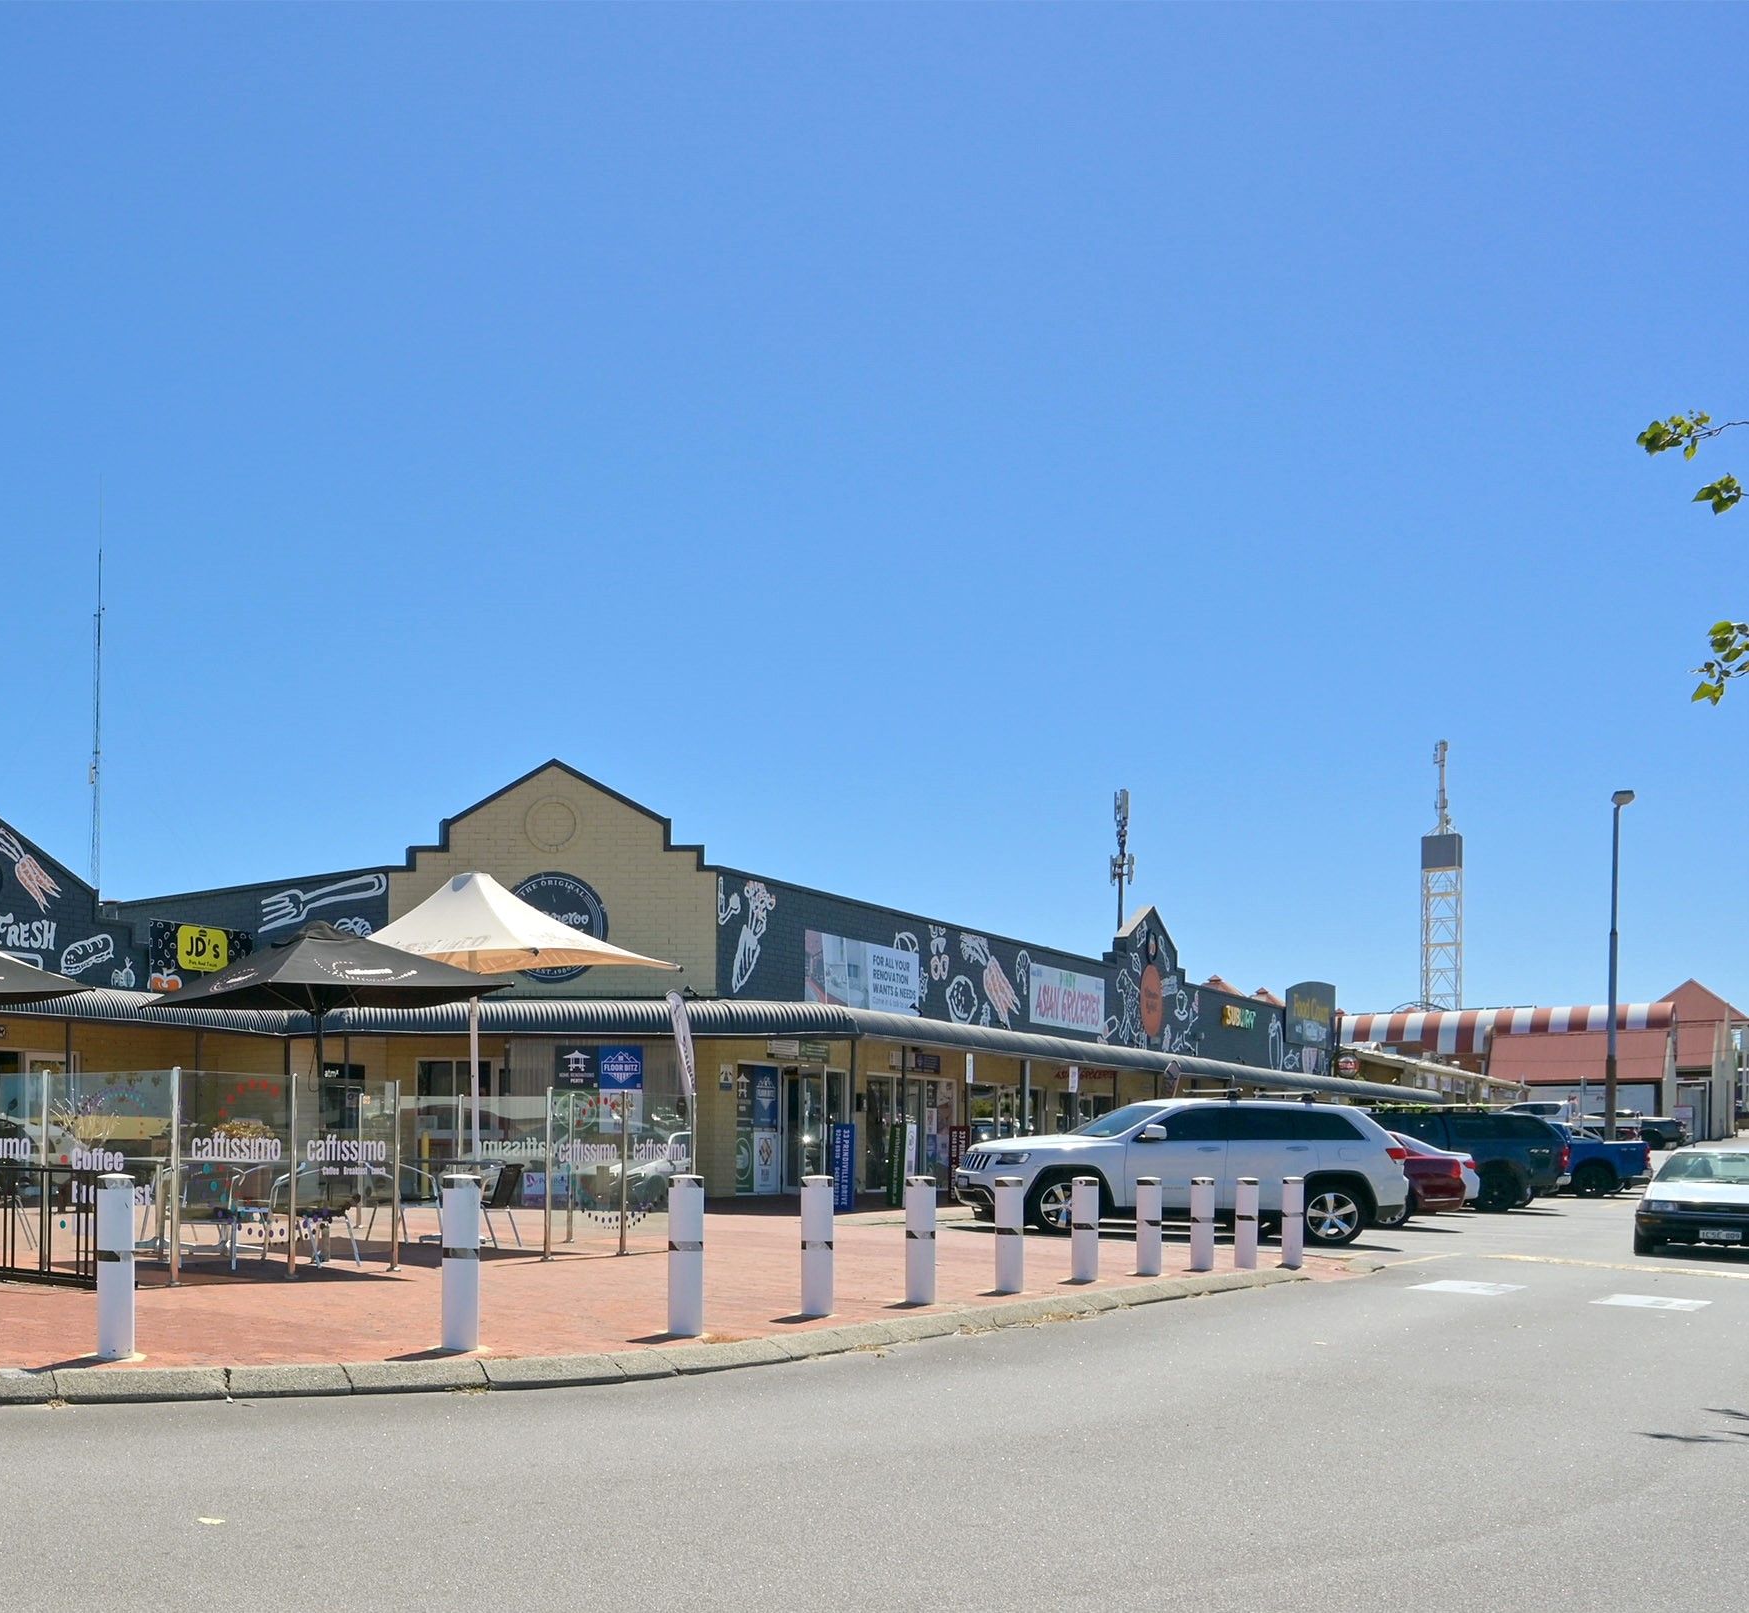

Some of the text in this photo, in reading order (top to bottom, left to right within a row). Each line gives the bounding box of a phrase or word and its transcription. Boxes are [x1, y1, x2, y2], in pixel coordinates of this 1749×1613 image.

[520, 879, 585, 898] THE ORIGINAL
[186, 936, 220, 959] JD's
[872, 954, 910, 972] FOR ALL YOUR
[872, 968, 909, 985] RENOVATION
[872, 983, 894, 997] WANTS
[899, 988, 916, 1000] NEEDS
[603, 1064, 638, 1072] FLOOR BITZ
[843, 1128, 850, 1138] 33
[191, 1131, 281, 1161] caffissimo
[307, 1134, 386, 1162] caffissimo
[559, 1138, 617, 1162] caffissimo
[633, 1138, 686, 1161] caffissimo
[71, 1147, 124, 1172] Coffee
[841, 1139, 850, 1183] PRINDIVILLE
[322, 1166, 339, 1176] Coffee
[343, 1166, 368, 1176] Breakfast
